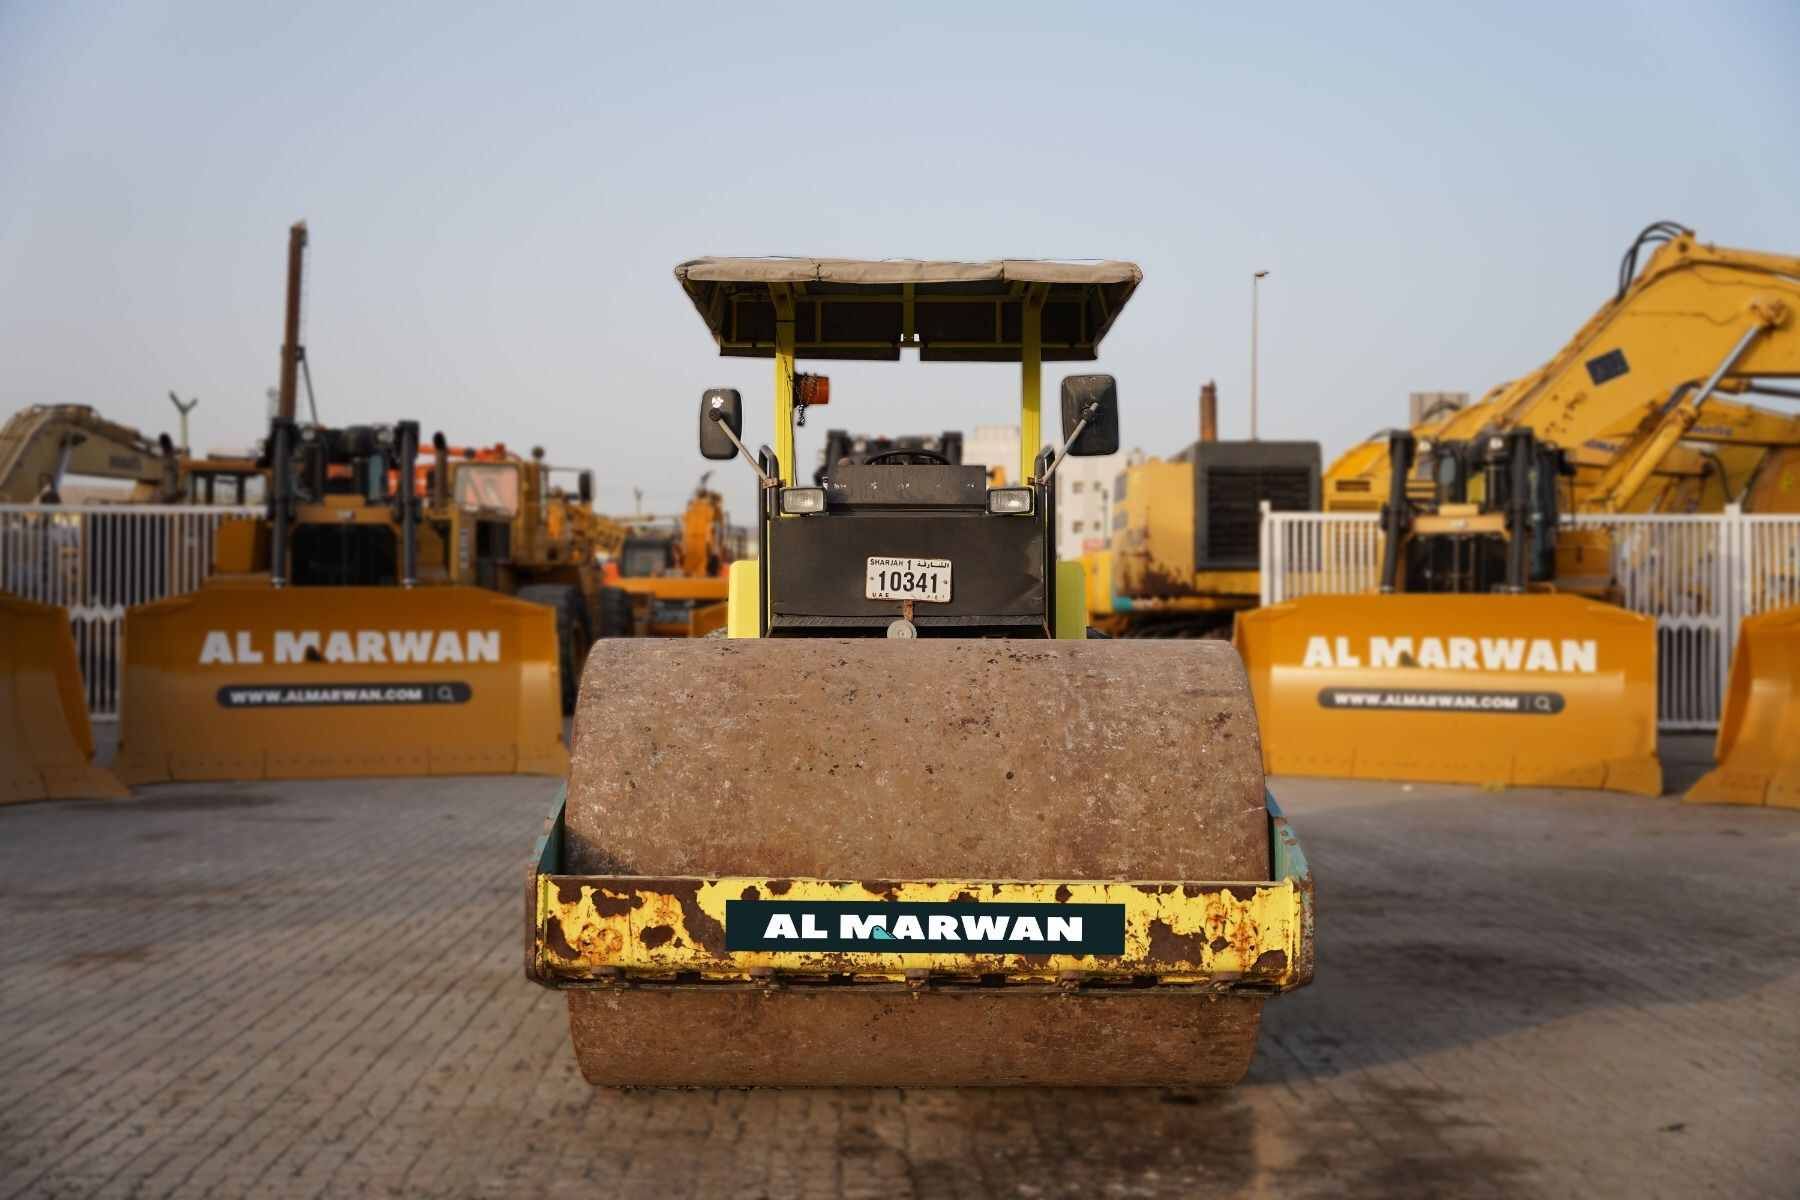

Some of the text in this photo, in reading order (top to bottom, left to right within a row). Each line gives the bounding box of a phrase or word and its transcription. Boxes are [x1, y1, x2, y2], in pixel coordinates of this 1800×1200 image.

[870, 558, 912, 571] SHARJAH 1
[879, 570, 937, 593] 10341
[200, 630, 500, 664] AL MARWAN
[1302, 635, 1599, 673] AL MARWAN
[230, 688, 423, 704] WWW.ALMARWAN.COM
[1333, 692, 1520, 710] WWW.ALMARWAN.COM
[763, 913, 1083, 942] AL MARWAN
